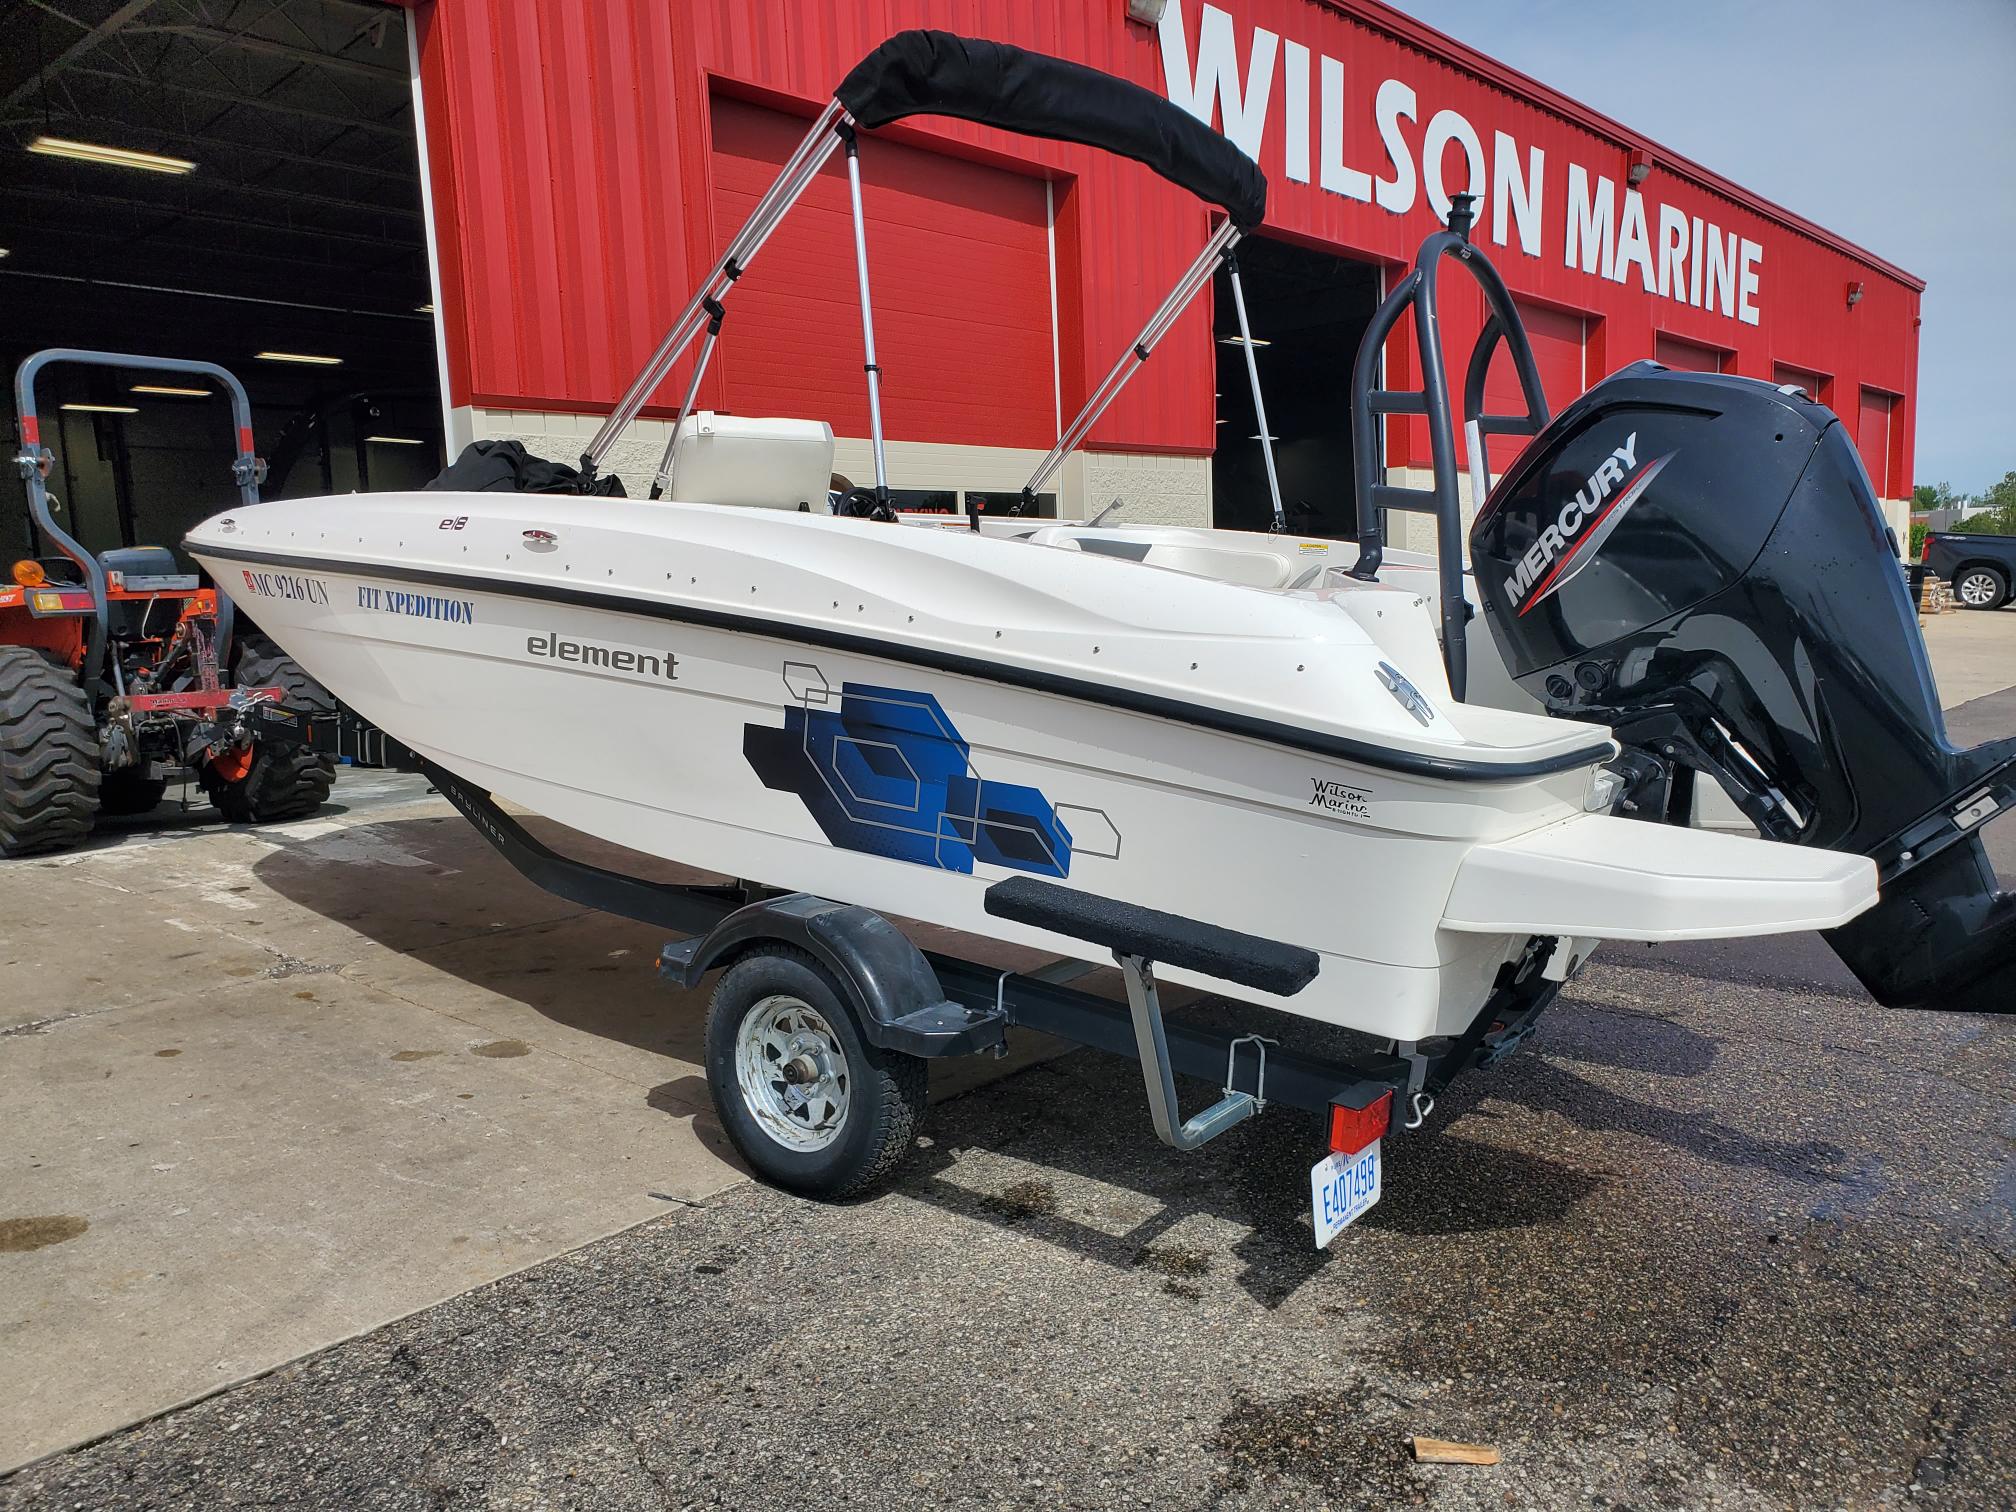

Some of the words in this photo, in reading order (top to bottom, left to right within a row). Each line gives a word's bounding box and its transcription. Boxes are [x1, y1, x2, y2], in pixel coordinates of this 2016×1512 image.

[1157, 0, 1544, 258] WILSON
[1564, 162, 1763, 326] MARINE
[1503, 431, 1639, 608] MERCURY
[252, 573, 276, 598] MC
[275, 574, 305, 600] 9216
[305, 578, 330, 606] UN
[357, 586, 381, 610] FIT
[385, 590, 474, 625] XPEDITION
[527, 632, 680, 680] element
[450, 785, 505, 846] BAYLINER
[1308, 793, 1368, 815] Marine
[1323, 1154, 1375, 1225] E407498
